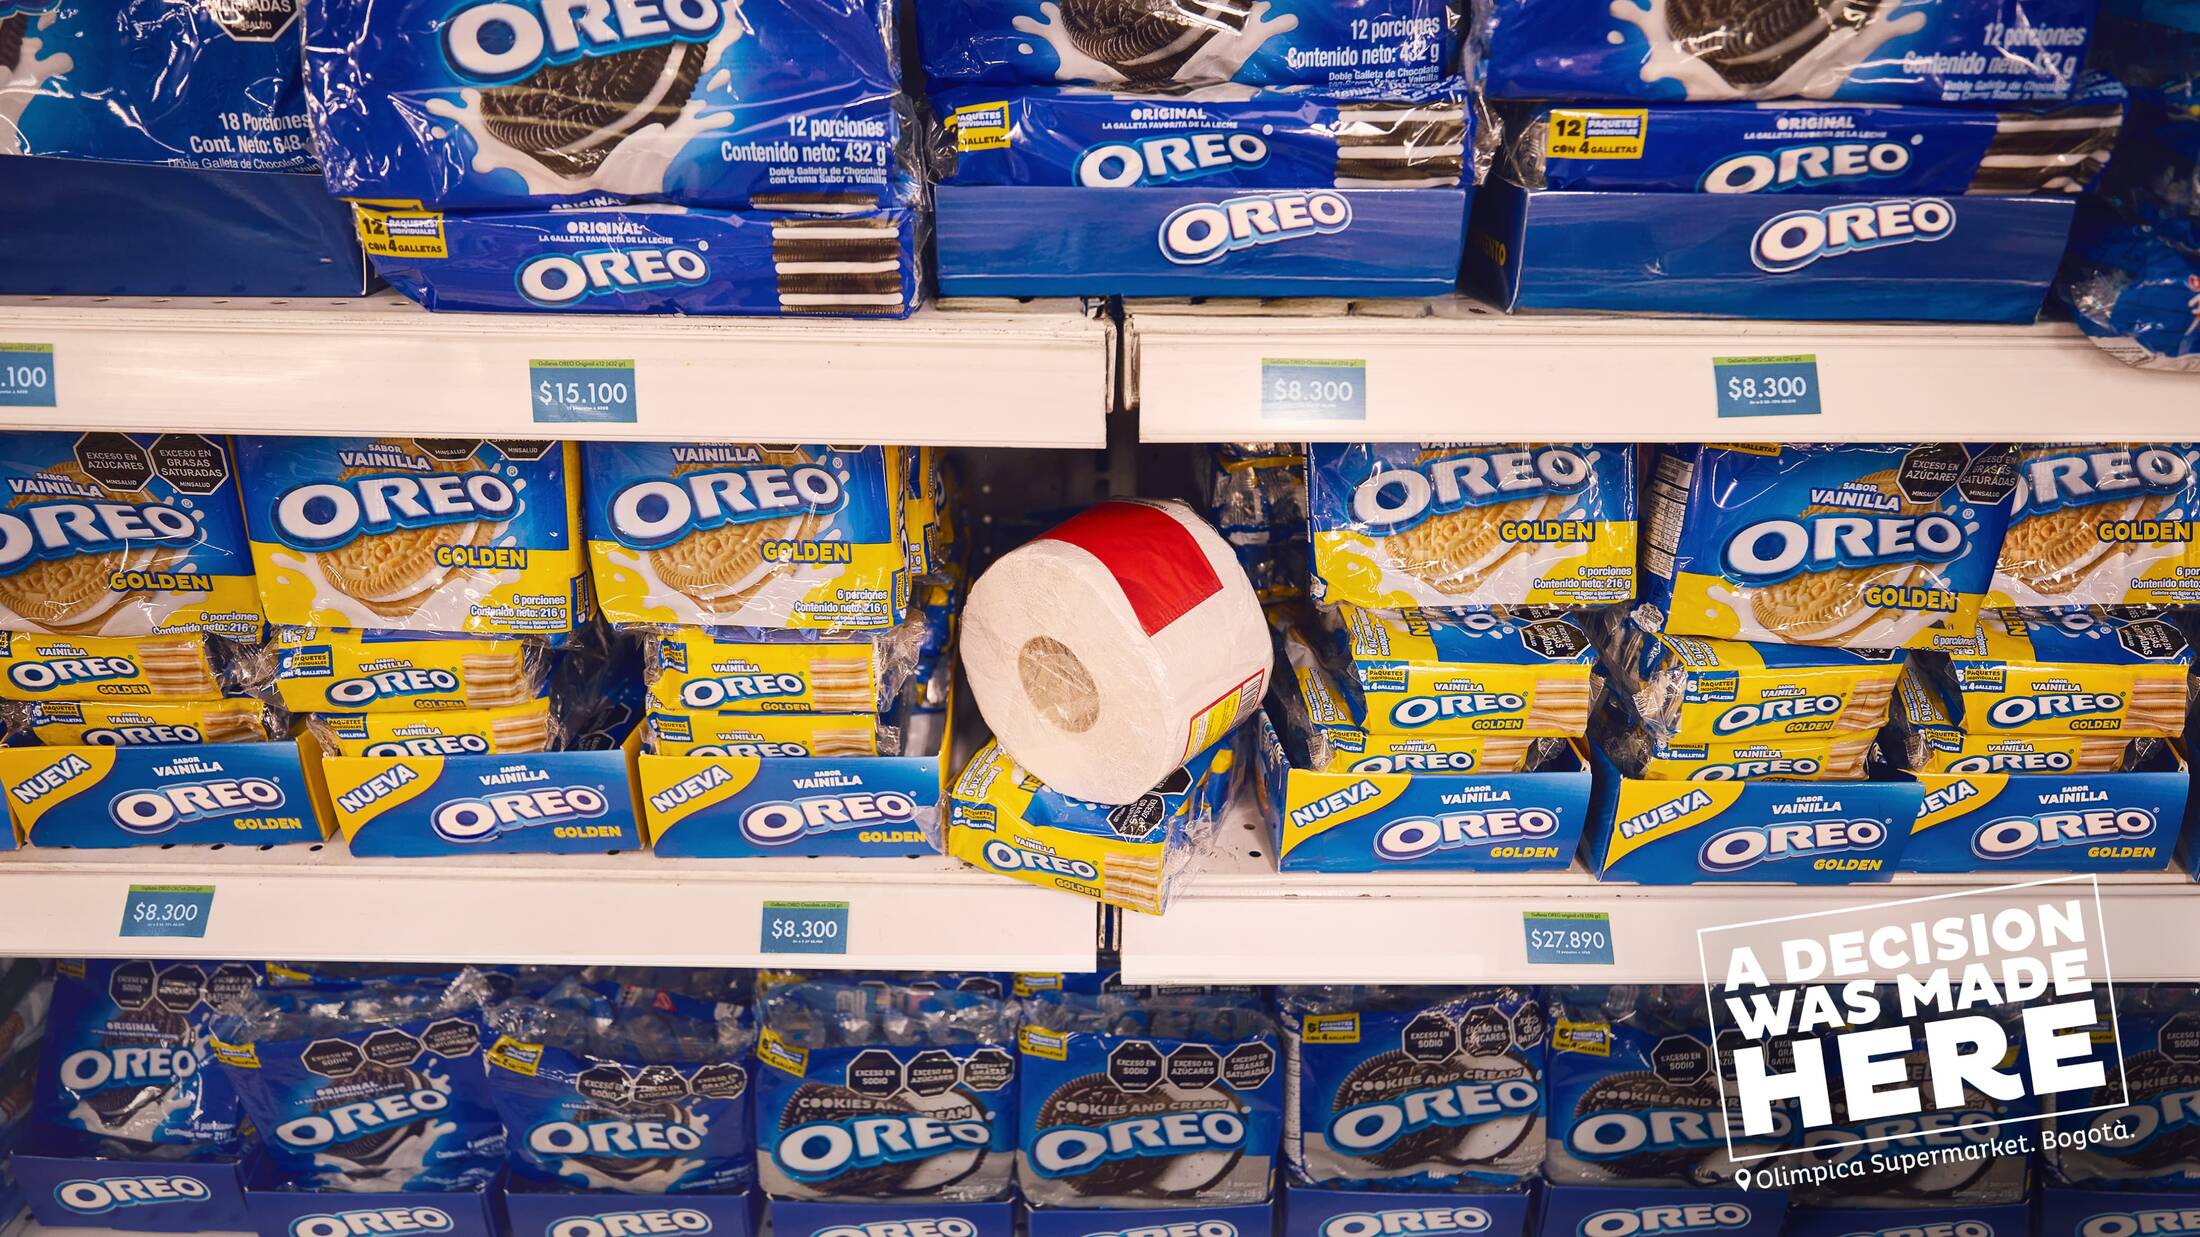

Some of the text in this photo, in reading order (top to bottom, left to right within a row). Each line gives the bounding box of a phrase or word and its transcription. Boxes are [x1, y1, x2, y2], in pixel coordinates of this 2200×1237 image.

[1351, 16, 1440, 42] 12 porciones
[1288, 47, 1357, 68] Contenido
[1362, 44, 1396, 64] neto:
[1431, 43, 1439, 62] g
[219, 113, 309, 131] 18 Porciones
[1131, 108, 1207, 120] ORIGINAL
[1777, 116, 1855, 130] ORIGINAL
[788, 116, 884, 140] 12 porciones
[722, 141, 886, 166] Contenido neto: 432 g
[1553, 145, 1575, 153] CON
[1579, 142, 1589, 153] 4
[567, 222, 642, 234] ORIGINAL
[1168, 196, 1346, 254] OREO
[1761, 203, 1950, 262] OREO
[551, 235, 585, 243] GALLETA
[586, 236, 625, 244] FAVORITA
[1, 367, 46, 387] .100
[539, 380, 627, 405] $15.100
[1274, 378, 1352, 401] $8.300
[1728, 376, 1806, 400] $8.300
[87, 453, 138, 461] EXCESO EN
[159, 449, 212, 458] EXCESO EN
[368, 444, 402, 453] SABOR
[672, 447, 760, 462] VAINILLA
[88, 459, 145, 470] AZÚCARES
[167, 458, 211, 467] GRASAS
[339, 451, 432, 471] VAINILLA
[1912, 460, 1959, 472] EXCESO EN
[161, 468, 223, 477] SATURADAS
[1906, 469, 1957, 482] AZÚCARES
[8, 479, 105, 498] VAINILLA
[1842, 482, 1878, 492] SABOR
[278, 475, 513, 538] OREO
[613, 467, 839, 538] OREO
[1502, 522, 1594, 540] GOLDEN
[2099, 522, 2191, 540] GOLDEN
[763, 542, 850, 562] GOLDEN
[1728, 516, 1962, 574] OREO
[437, 547, 525, 567] GOLDEN
[1578, 565, 1631, 578] 6 porciones
[111, 573, 211, 591] GOLDEN
[1534, 578, 1630, 589] Contenido neto: 216 g
[514, 594, 565, 606] 6 porciones
[794, 602, 888, 614] Contenido neto: 216 g
[516, 608, 538, 617] neto:
[540, 608, 557, 617] 216
[560, 609, 566, 618] g
[153, 624, 248, 634] Contenido neto: 216
[13, 659, 135, 687] OREO
[360, 661, 411, 671] VAINILLA
[99, 686, 149, 694] GOLDEN
[331, 670, 455, 702] OREO
[684, 675, 802, 706] OREO
[1435, 683, 1483, 692] VAINILLA
[1761, 688, 1806, 698] VAINILLA
[2032, 683, 2081, 691] VAINILLA
[1395, 695, 1524, 724] OREO
[1718, 696, 1841, 730] OREO
[1992, 694, 2122, 724] OREO
[1473, 720, 1521, 729] GOLDEN
[1786, 721, 1832, 732] GOLDEN
[2071, 720, 2119, 729] GOLDEN
[153, 761, 223, 776] VAINILLA
[15, 756, 90, 803] NUEVA
[479, 770, 549, 786] VAINILLA
[793, 775, 862, 789] VAINILLA
[339, 765, 418, 813] NUEVA
[651, 766, 732, 813] NUEVA
[1441, 790, 1511, 805] VAINILLA
[117, 782, 278, 826] OREO
[1292, 781, 1380, 827] NUEVA
[1772, 801, 1841, 814] VAINILLA
[2039, 792, 2108, 805] VAINILLA
[439, 789, 601, 836] OREO
[747, 795, 911, 837] OREO
[1620, 790, 1712, 838] NUEVA
[234, 819, 302, 830] GOLDEN
[554, 826, 621, 838] GOLDEN
[1380, 811, 1556, 852] OREO
[1980, 812, 2150, 852] OREO
[1707, 822, 1881, 864] OREO
[988, 843, 1096, 878] OREO
[1491, 847, 1558, 858] GOLDEN
[2088, 847, 2156, 858] GOLDEN
[1814, 860, 1882, 870] GOLDEN
[1056, 879, 1100, 896] GOLDEN
[133, 902, 198, 922] $8.300
[772, 919, 838, 939] $8.300
[1532, 929, 1604, 949] $27.890
[61, 1048, 196, 1089] OREO
[1171, 1066, 1215, 1075] AZÚCARES
[1352, 1069, 1523, 1091] COOKIES AND CREAM
[799, 1098, 871, 1109] COOKIES
[1596, 1090, 1712, 1106] COOKIES AND
[1056, 1101, 1228, 1115] COOKIES AND CREAM
[1333, 1081, 1538, 1148] OREO
[276, 1091, 447, 1145] OREO
[531, 1122, 701, 1153] OREO
[1036, 1113, 1244, 1171] OREO
[61, 1178, 204, 1208] OREO
